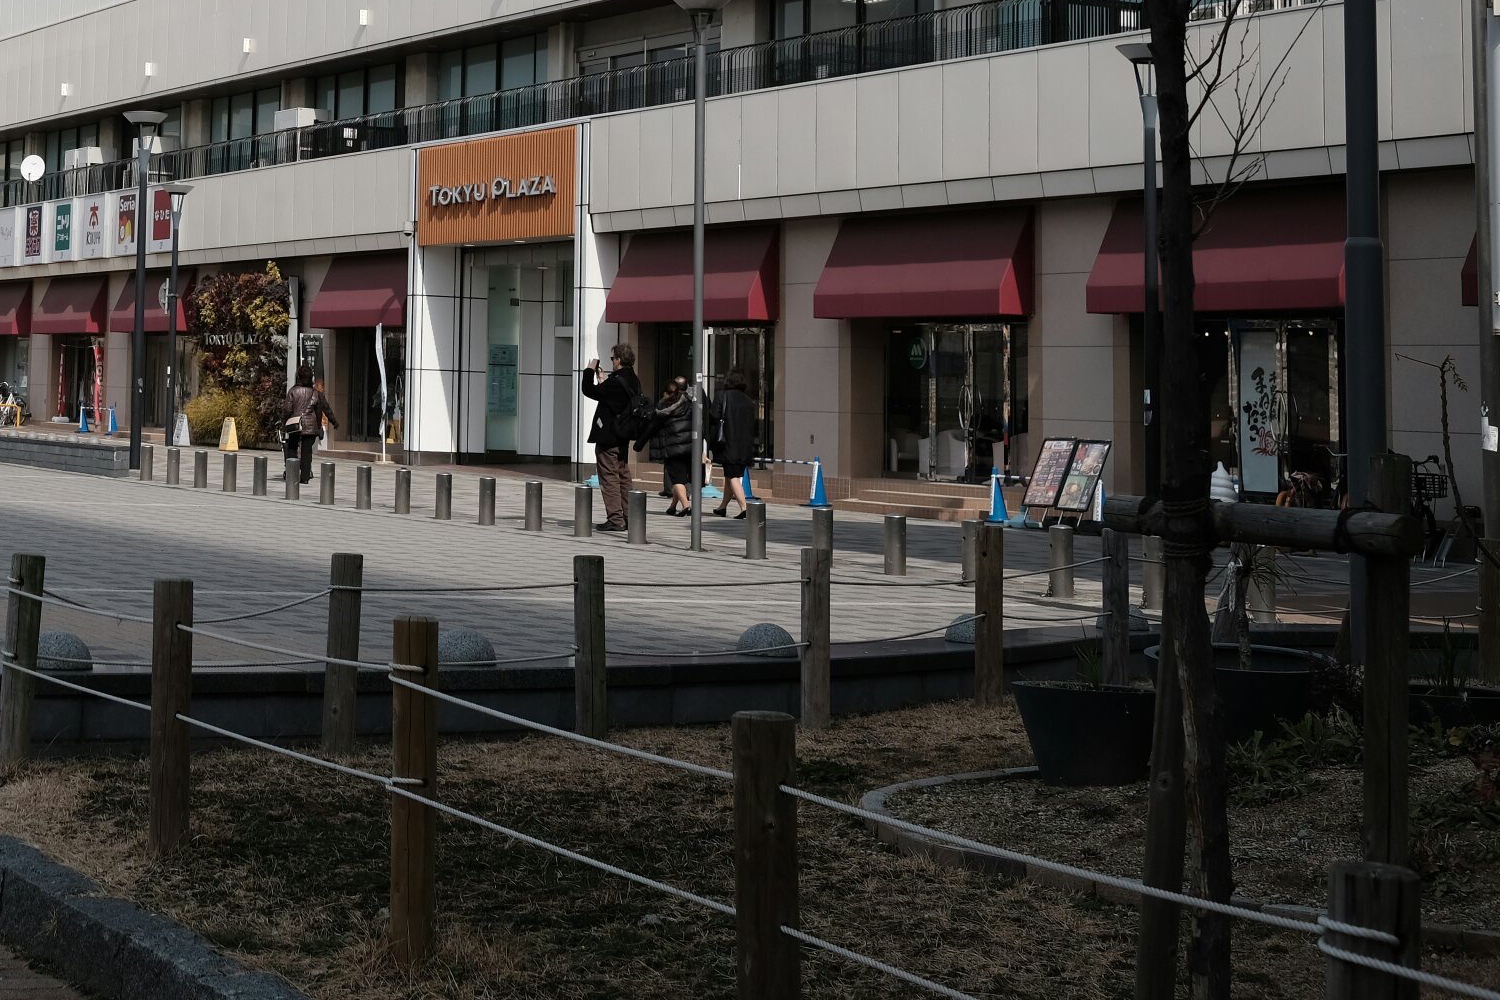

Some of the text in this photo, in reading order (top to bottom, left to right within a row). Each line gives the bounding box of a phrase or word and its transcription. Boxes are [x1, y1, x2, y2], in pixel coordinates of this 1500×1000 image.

[430, 174, 554, 206] TOKYU PLAZA
[120, 197, 136, 212] Seria
[56, 214, 70, 230] ニトリ
[204, 332, 233, 346] TOKYU
